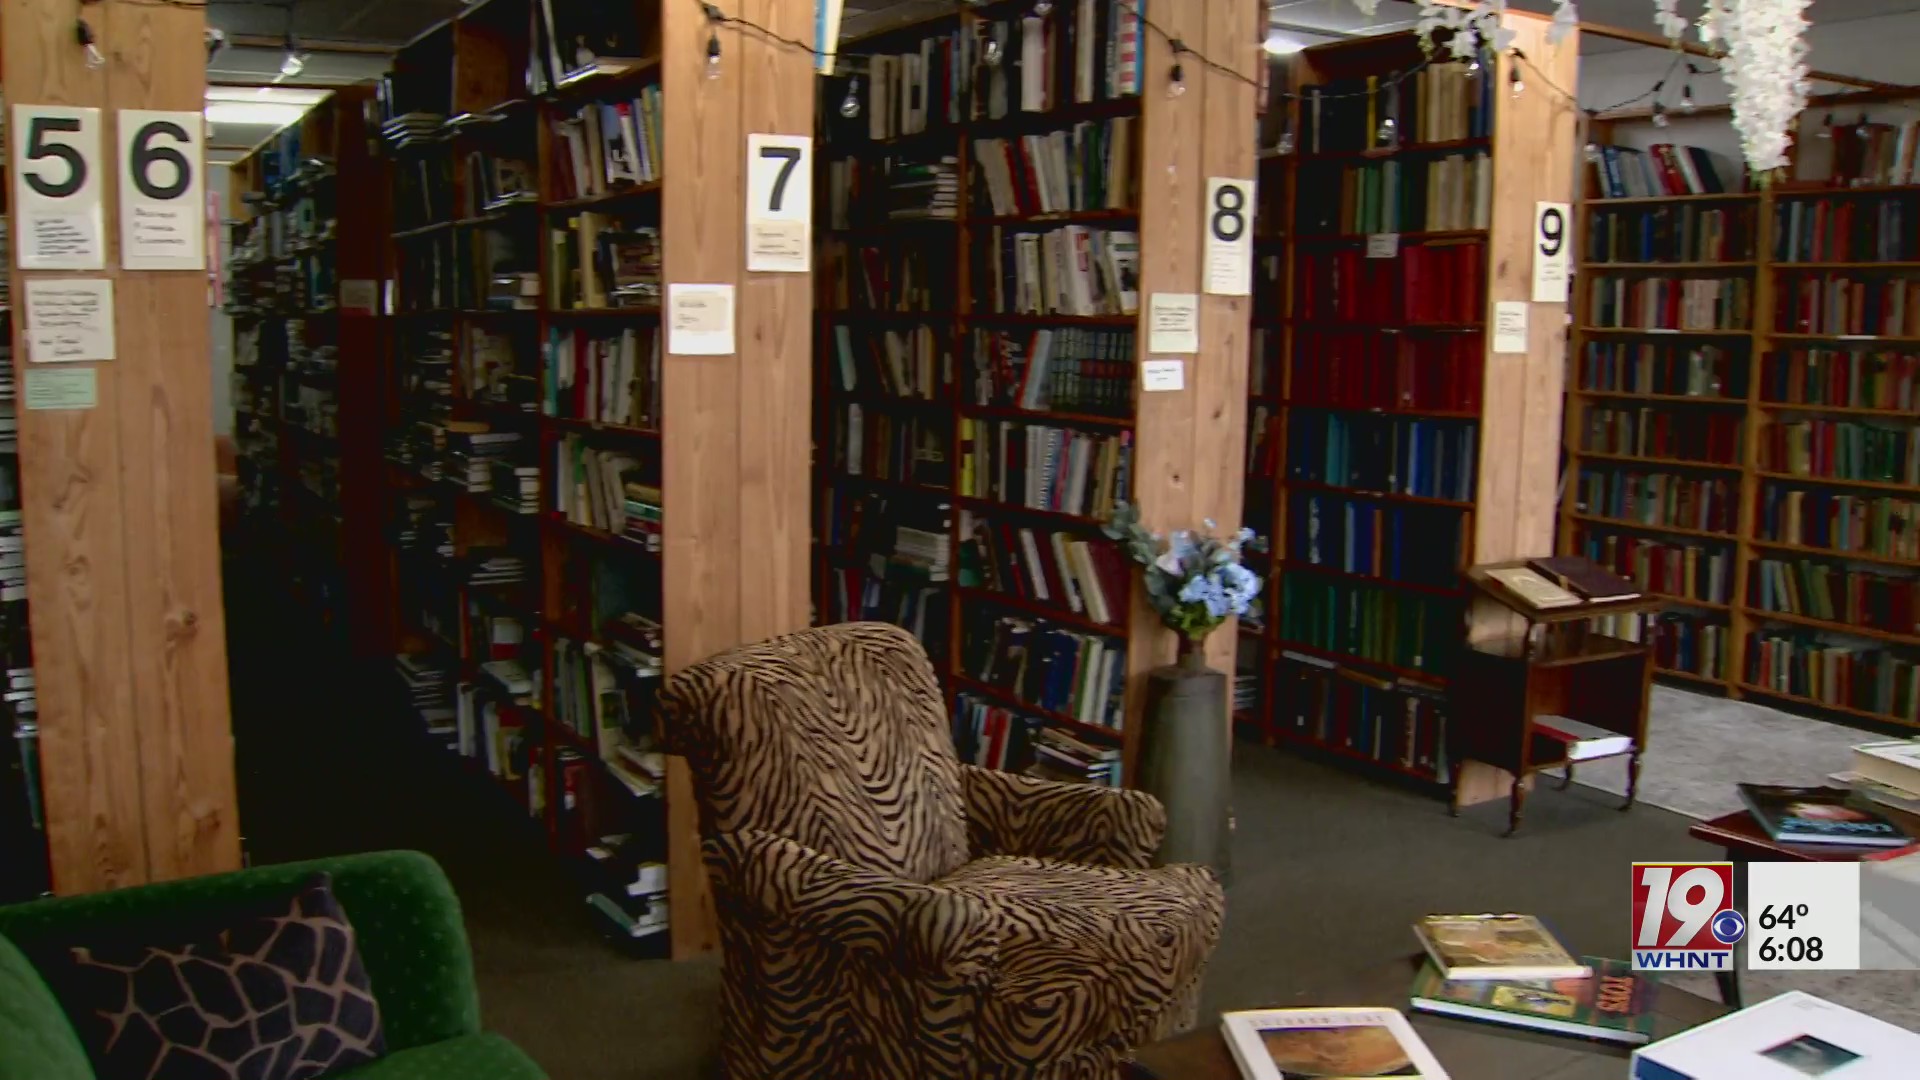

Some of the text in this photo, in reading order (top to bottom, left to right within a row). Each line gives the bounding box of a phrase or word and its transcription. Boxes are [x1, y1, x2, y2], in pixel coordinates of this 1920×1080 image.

[23, 117, 87, 198] 5
[130, 120, 192, 200] 6
[760, 146, 802, 212] 7
[1212, 184, 1245, 242] 8
[1539, 207, 1564, 257] 9
